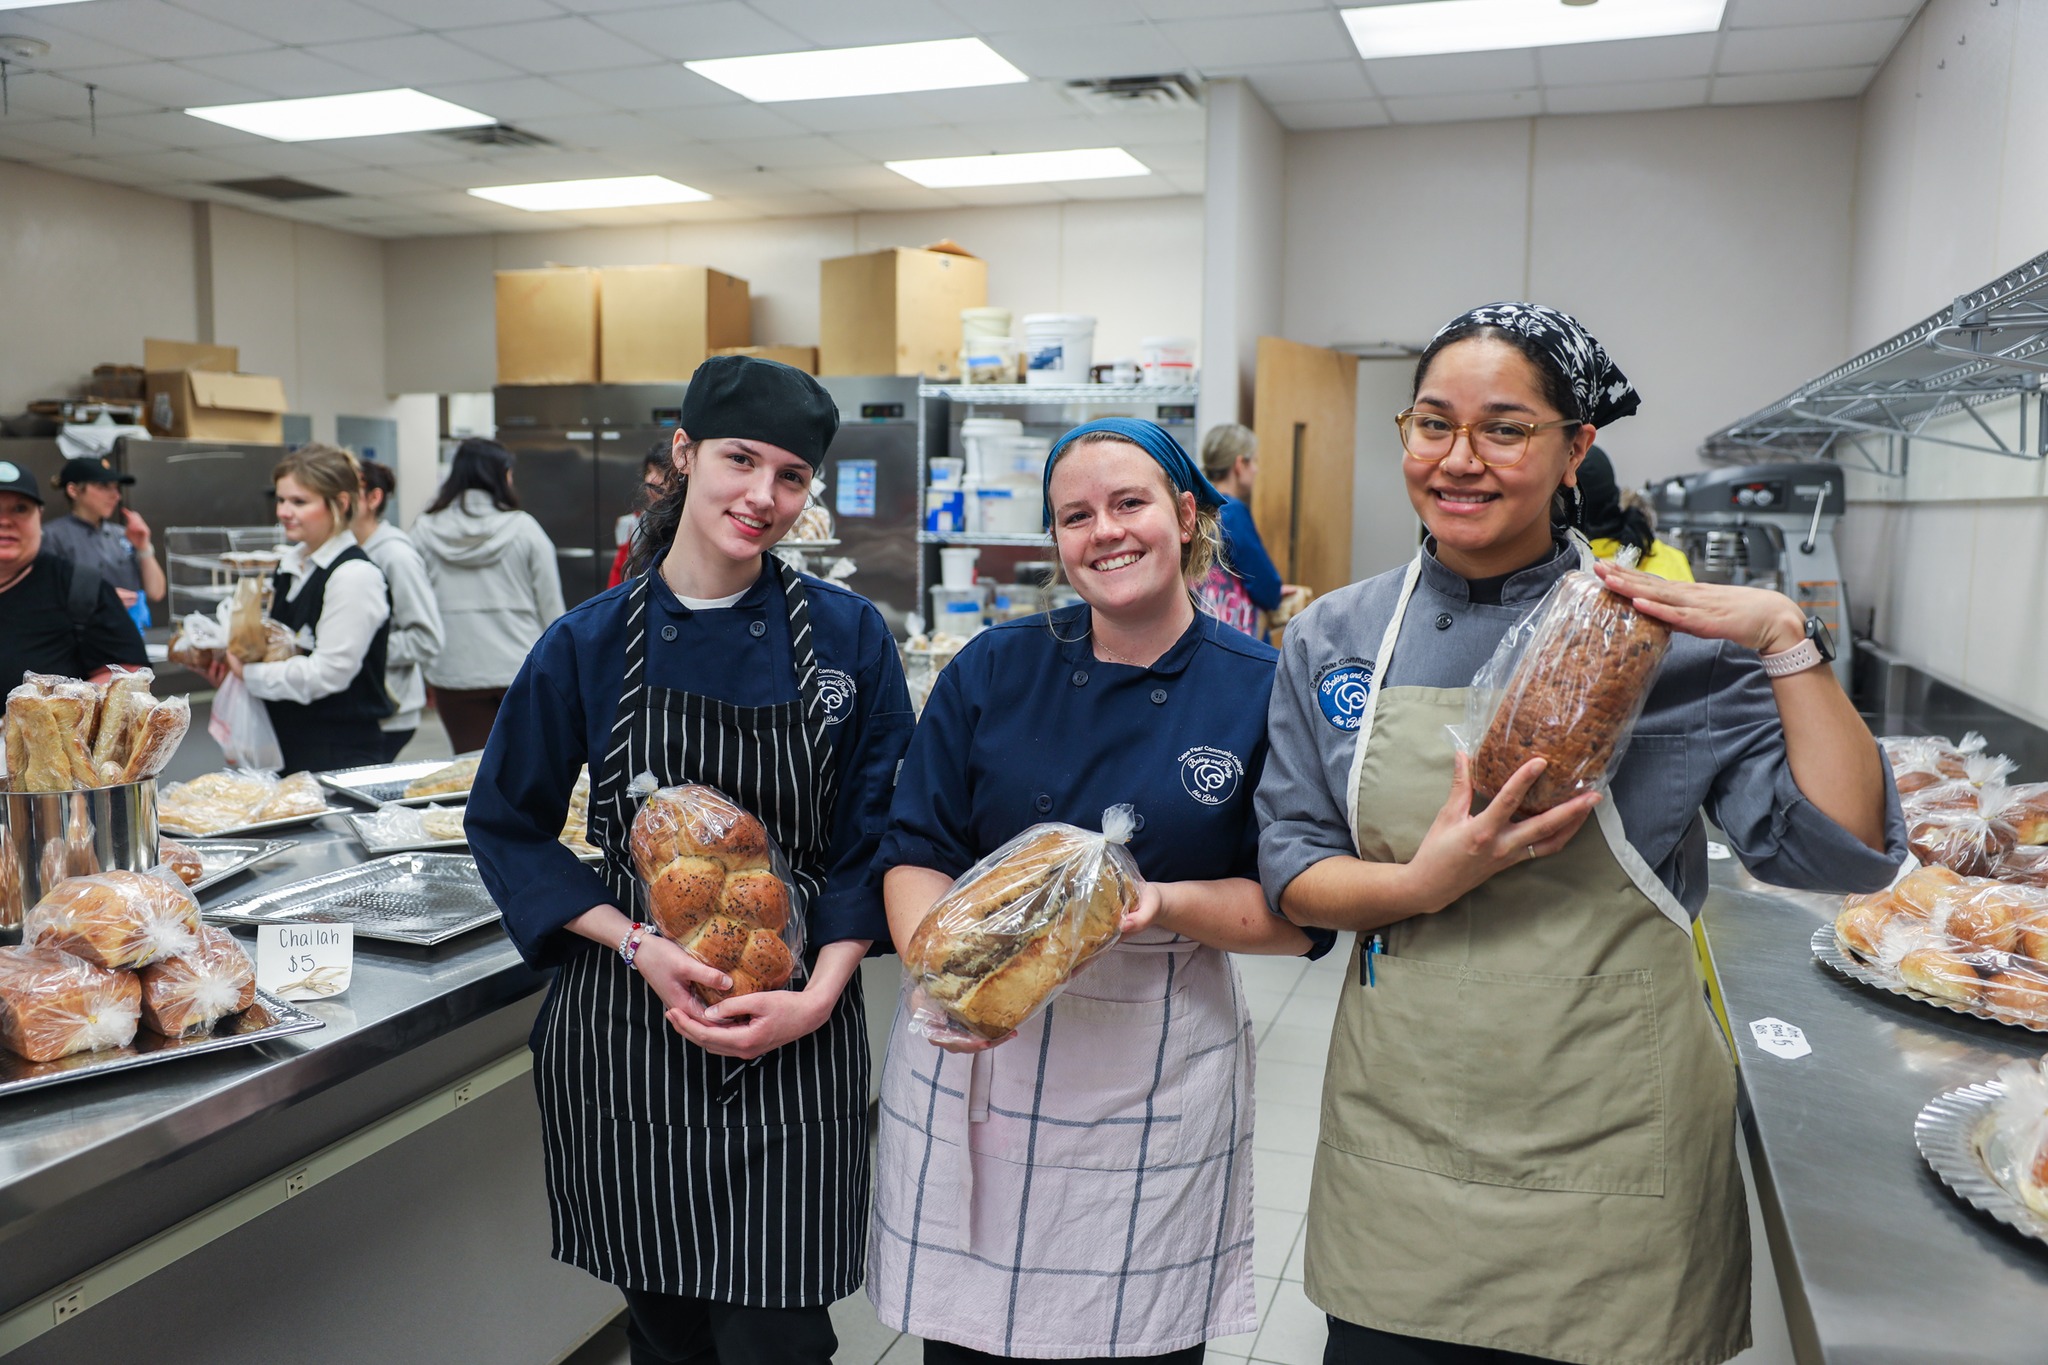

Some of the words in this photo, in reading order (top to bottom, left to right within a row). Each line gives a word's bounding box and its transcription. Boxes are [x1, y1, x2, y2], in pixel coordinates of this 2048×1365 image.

[1321, 673, 1348, 695] Baking
[1349, 671, 1364, 679] and
[1177, 750, 1191, 762] Cape
[1189, 745, 1204, 753] Fear
[1204, 745, 1233, 758] Community
[1232, 755, 1244, 776] College
[1187, 756, 1211, 769] Baking
[279, 928, 340, 948] Challah
[287, 953, 316, 973] $5
